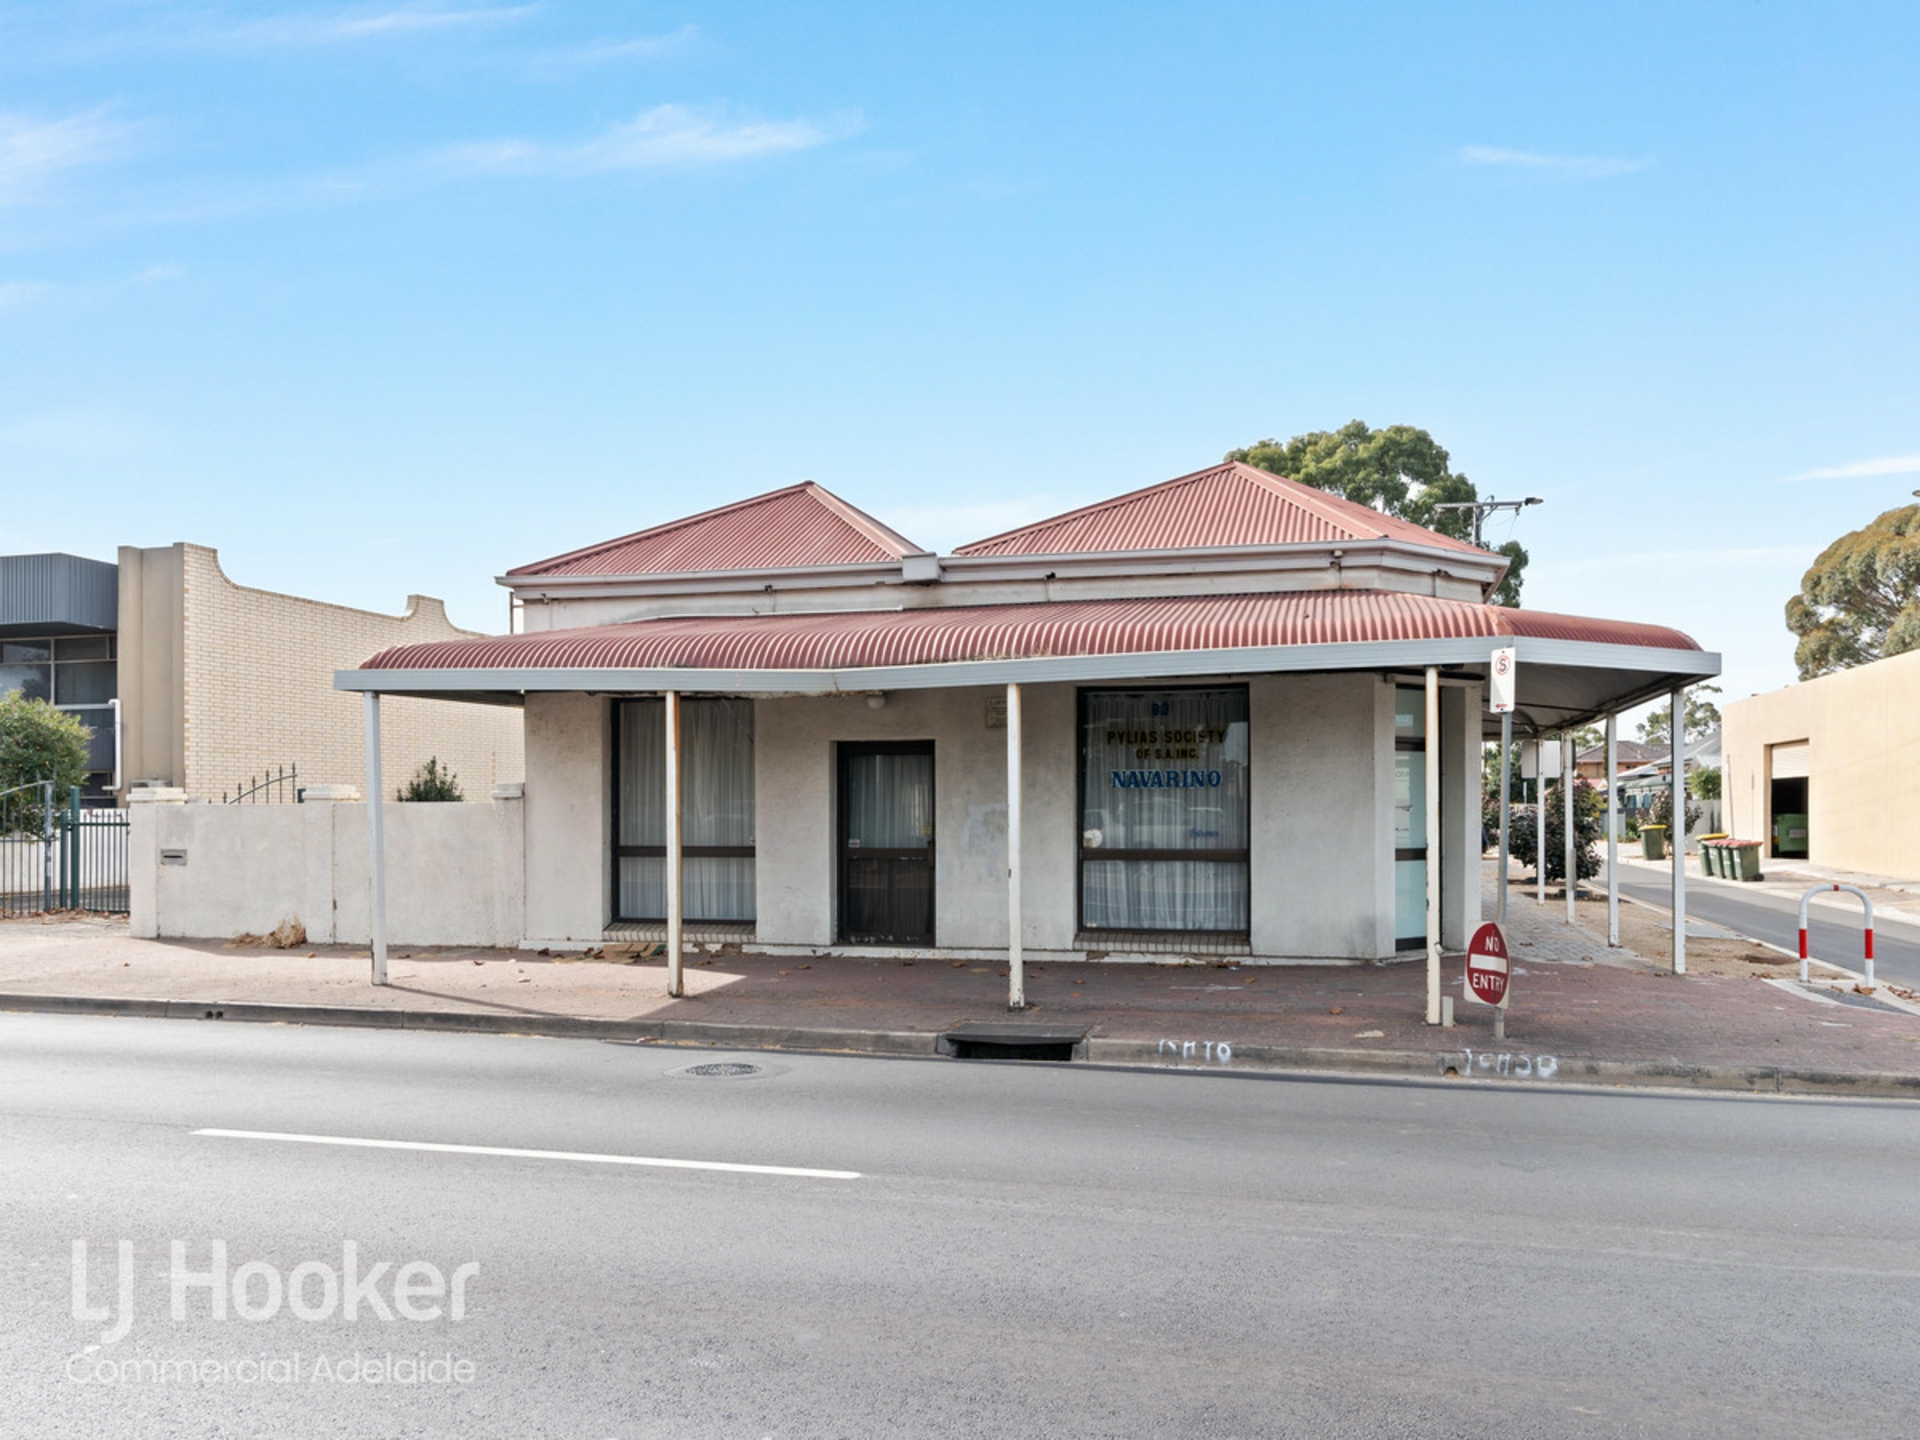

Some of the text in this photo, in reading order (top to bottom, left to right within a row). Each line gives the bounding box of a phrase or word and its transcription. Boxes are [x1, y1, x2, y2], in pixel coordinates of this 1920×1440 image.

[1107, 728, 1228, 745] PYLIAS SOCIETY
[1135, 747, 1151, 760] OF
[1111, 769, 1222, 789] NAVARINO
[1484, 935, 1500, 952] NO
[1472, 972, 1505, 993] ENTRY
